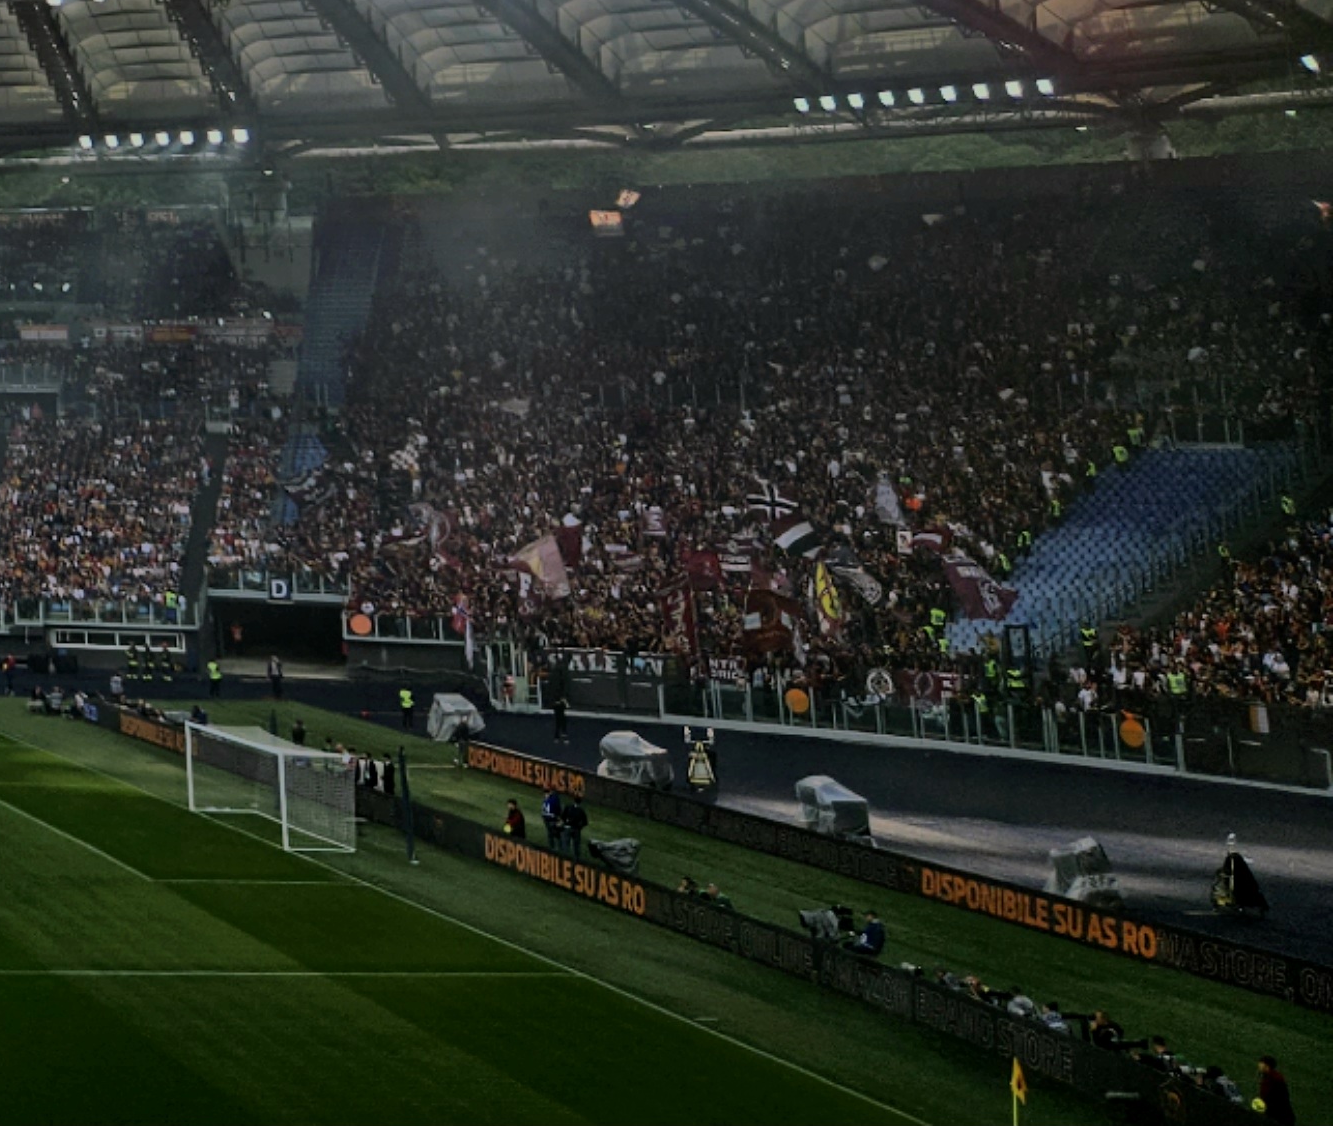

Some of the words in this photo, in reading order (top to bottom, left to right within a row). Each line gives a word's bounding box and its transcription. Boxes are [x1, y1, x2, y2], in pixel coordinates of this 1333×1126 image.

[270, 578, 288, 599] D
[484, 832, 573, 889] DISPONIBILE
[574, 863, 596, 897] SU
[597, 872, 619, 906] AS
[921, 867, 1050, 931] DISPONIBILE
[1052, 902, 1083, 939] SU
[1086, 912, 1118, 949] AS
